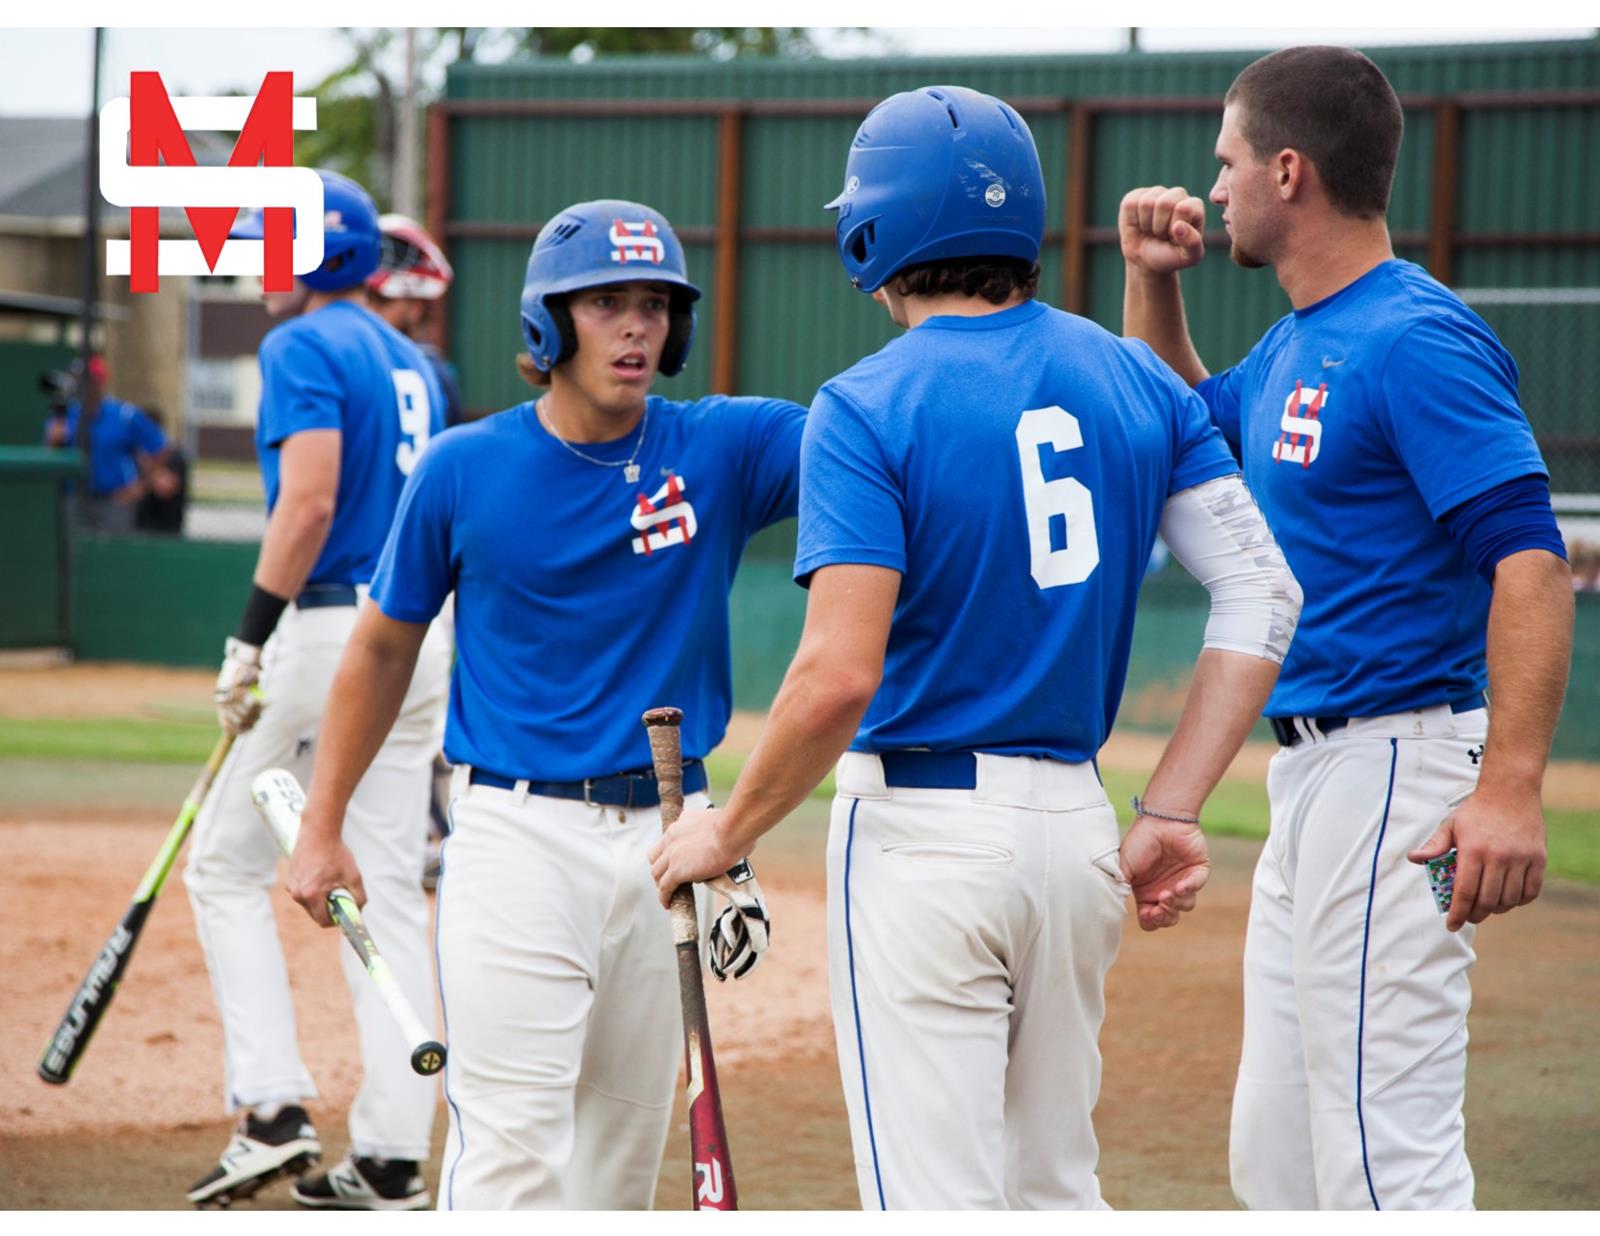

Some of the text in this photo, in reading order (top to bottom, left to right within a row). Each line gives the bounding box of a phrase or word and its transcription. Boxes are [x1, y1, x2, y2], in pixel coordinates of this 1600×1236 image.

[391, 368, 430, 478] 9
[1015, 405, 1100, 590] 6
[45, 925, 132, 1076] RAWLINGS
